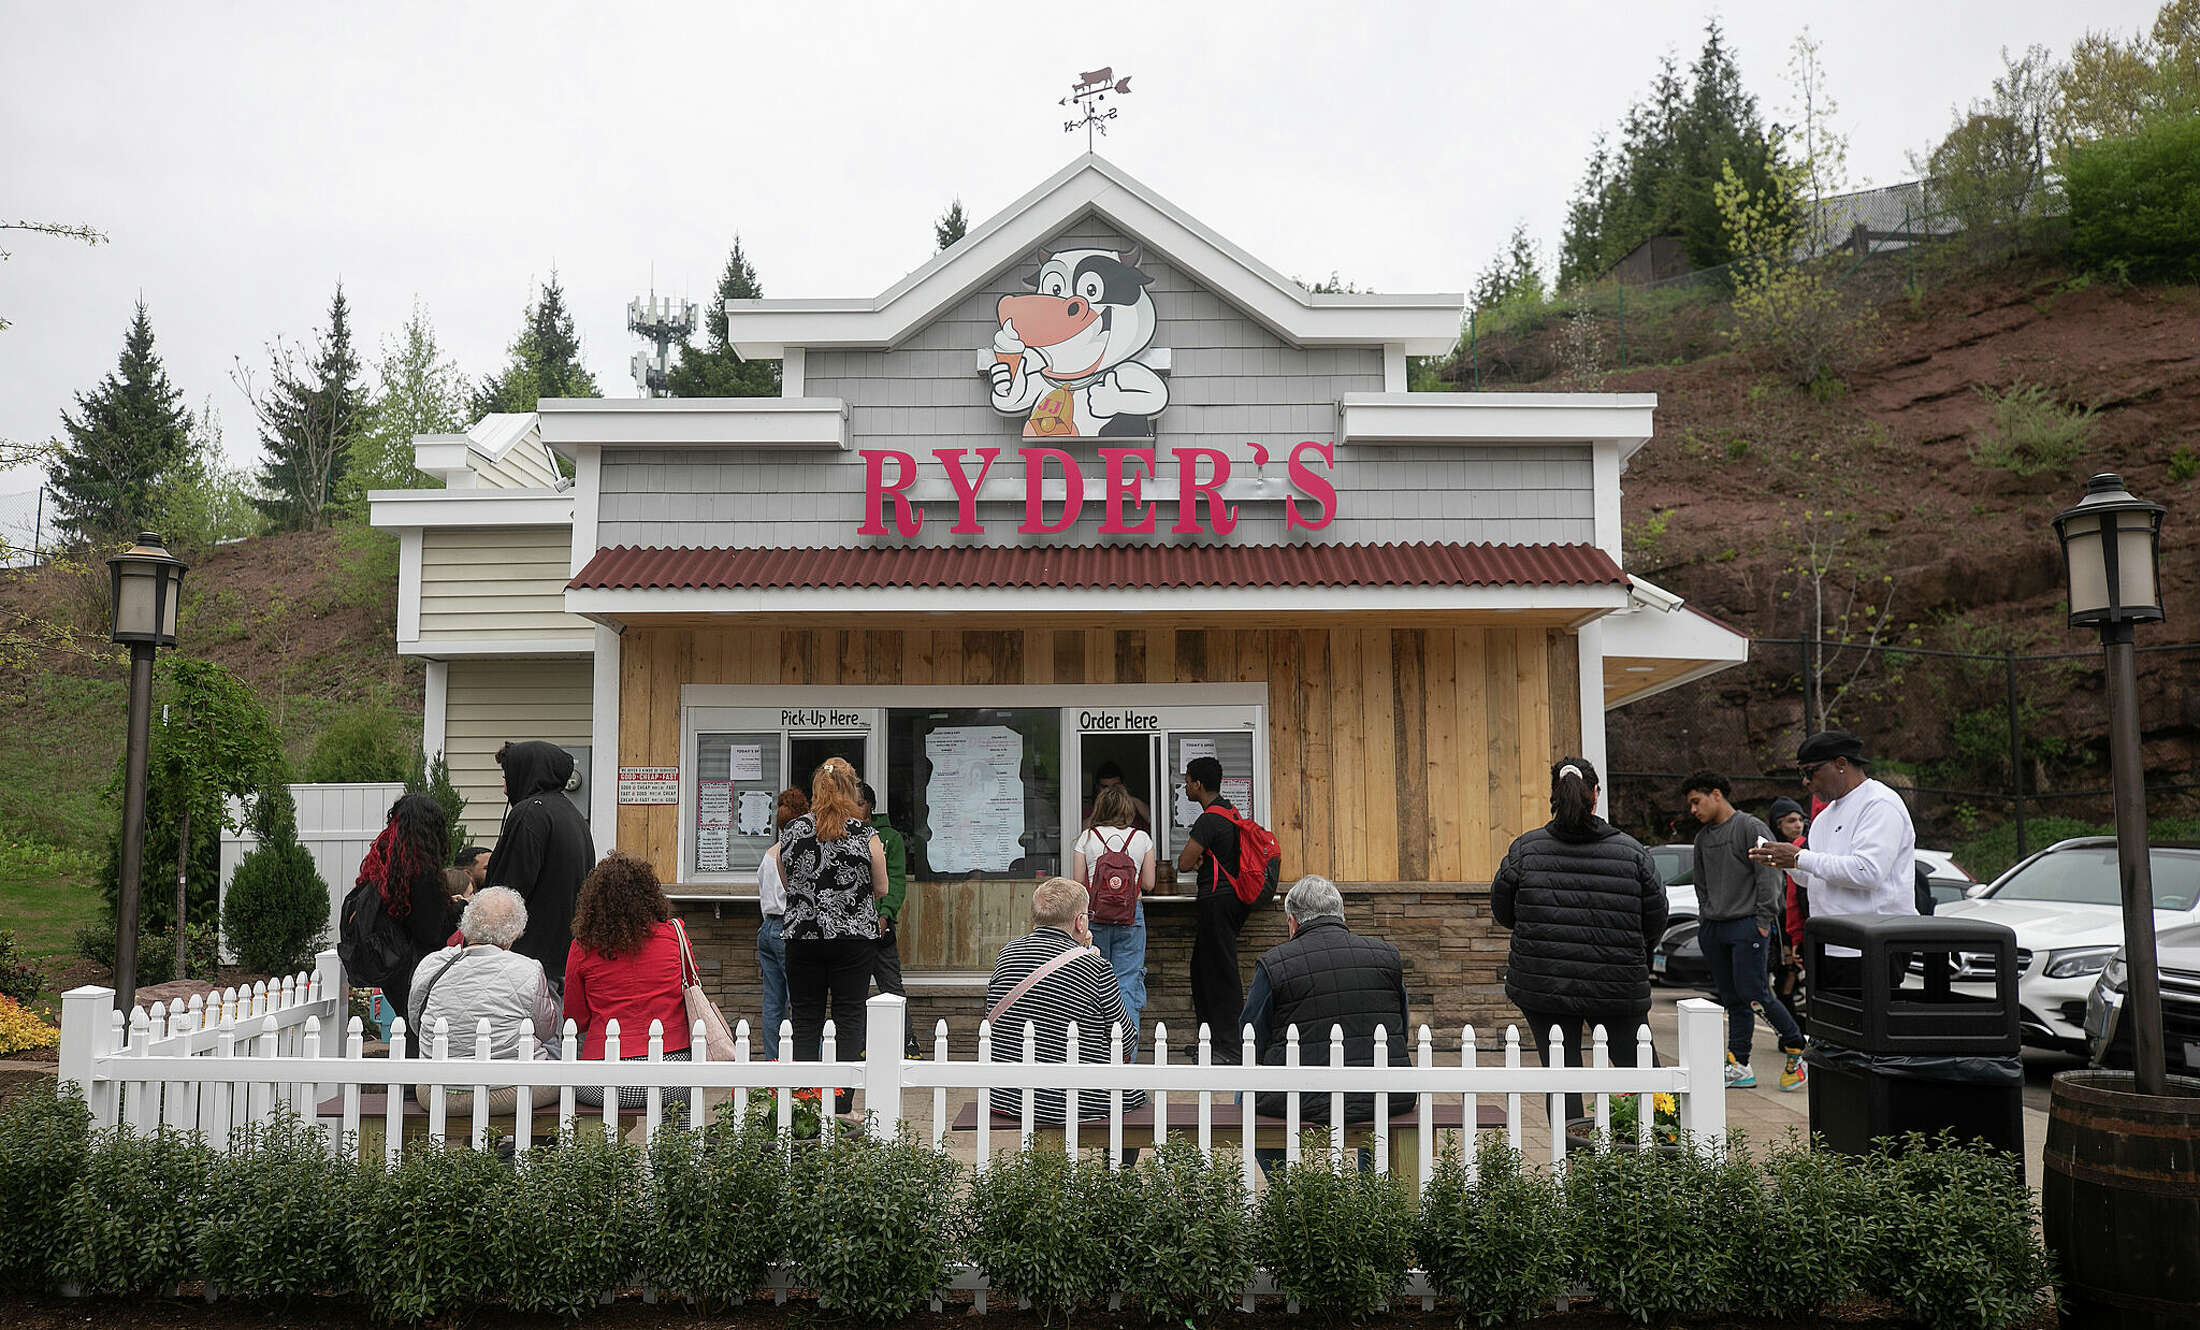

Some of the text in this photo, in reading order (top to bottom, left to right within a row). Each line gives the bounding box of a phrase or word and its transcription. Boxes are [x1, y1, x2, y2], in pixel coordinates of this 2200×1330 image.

[1037, 398, 1062, 414] JJ
[857, 441, 1338, 536] RYDER'S
[781, 710, 859, 728] Pick-Up Here
[1080, 710, 1158, 729] Order Here
